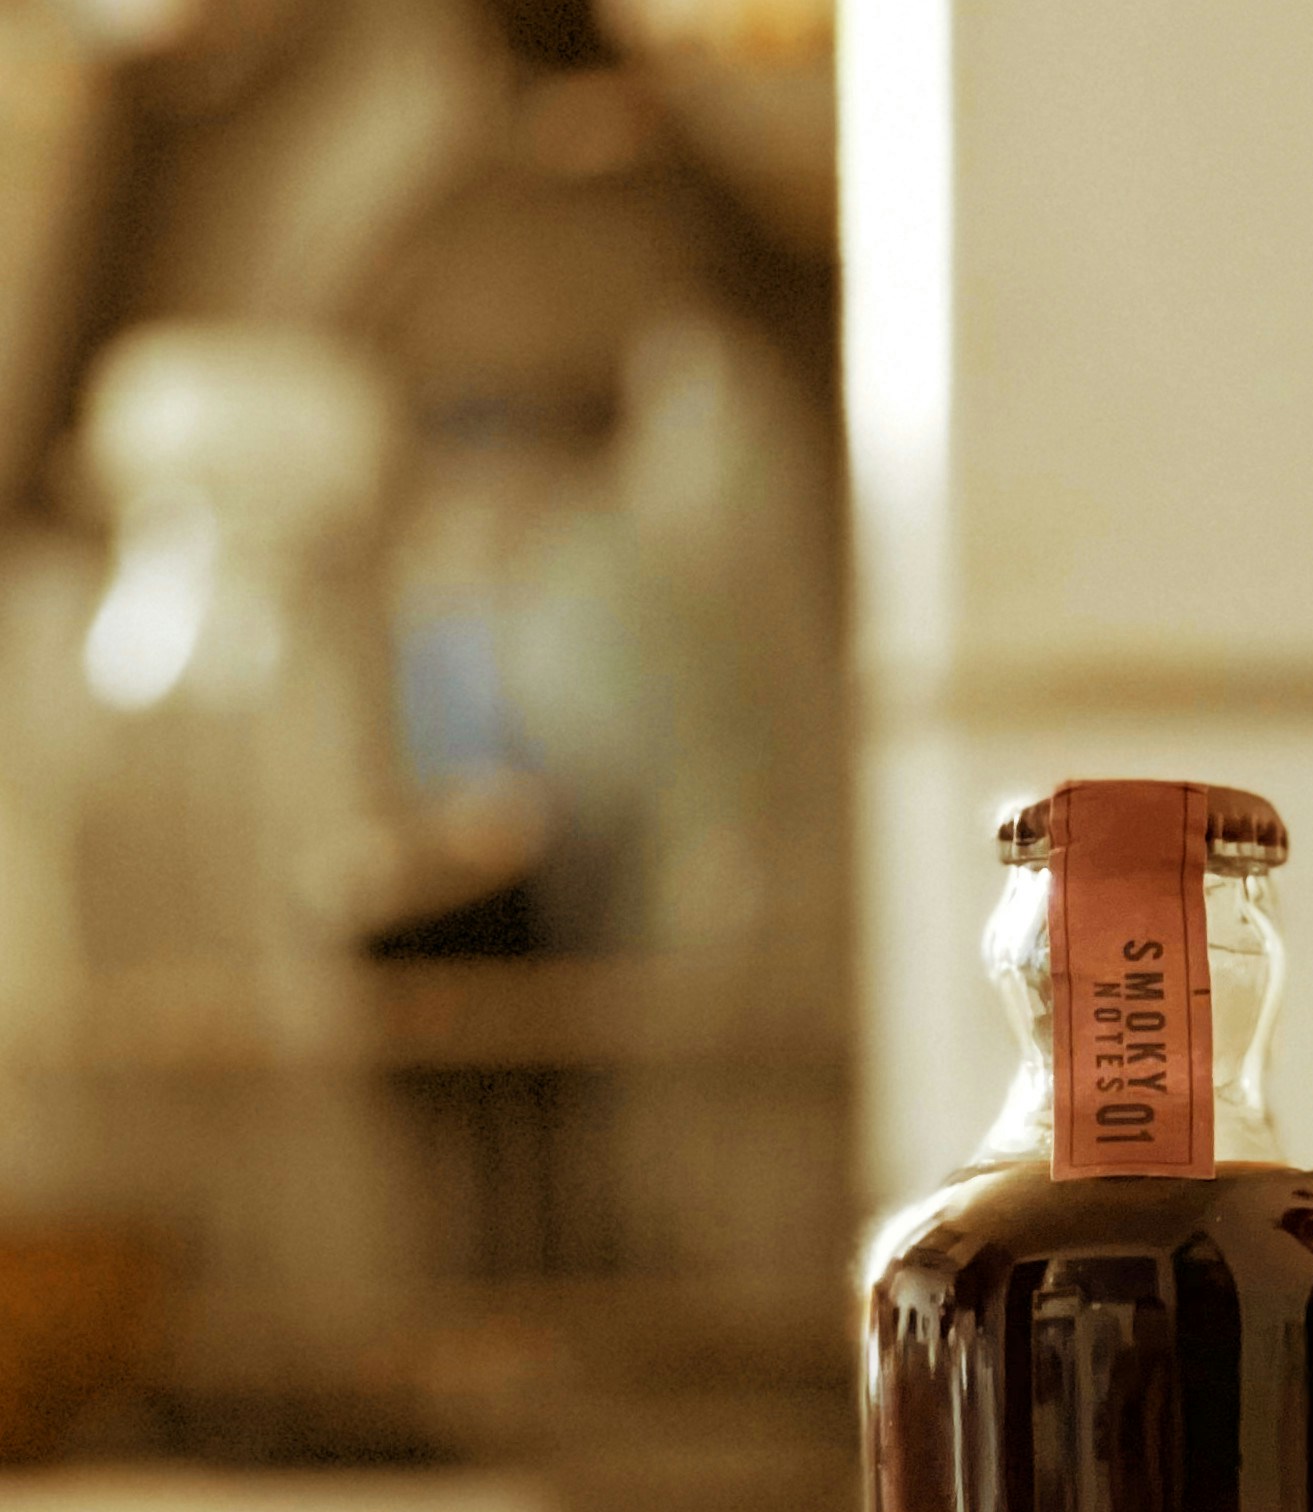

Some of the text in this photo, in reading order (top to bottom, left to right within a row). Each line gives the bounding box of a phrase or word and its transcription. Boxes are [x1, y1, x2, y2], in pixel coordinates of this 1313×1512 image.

[1093, 982, 1125, 1093] NOTES
[1123, 939, 1167, 1094] SMOKY
[1095, 1103, 1155, 1145] 01
